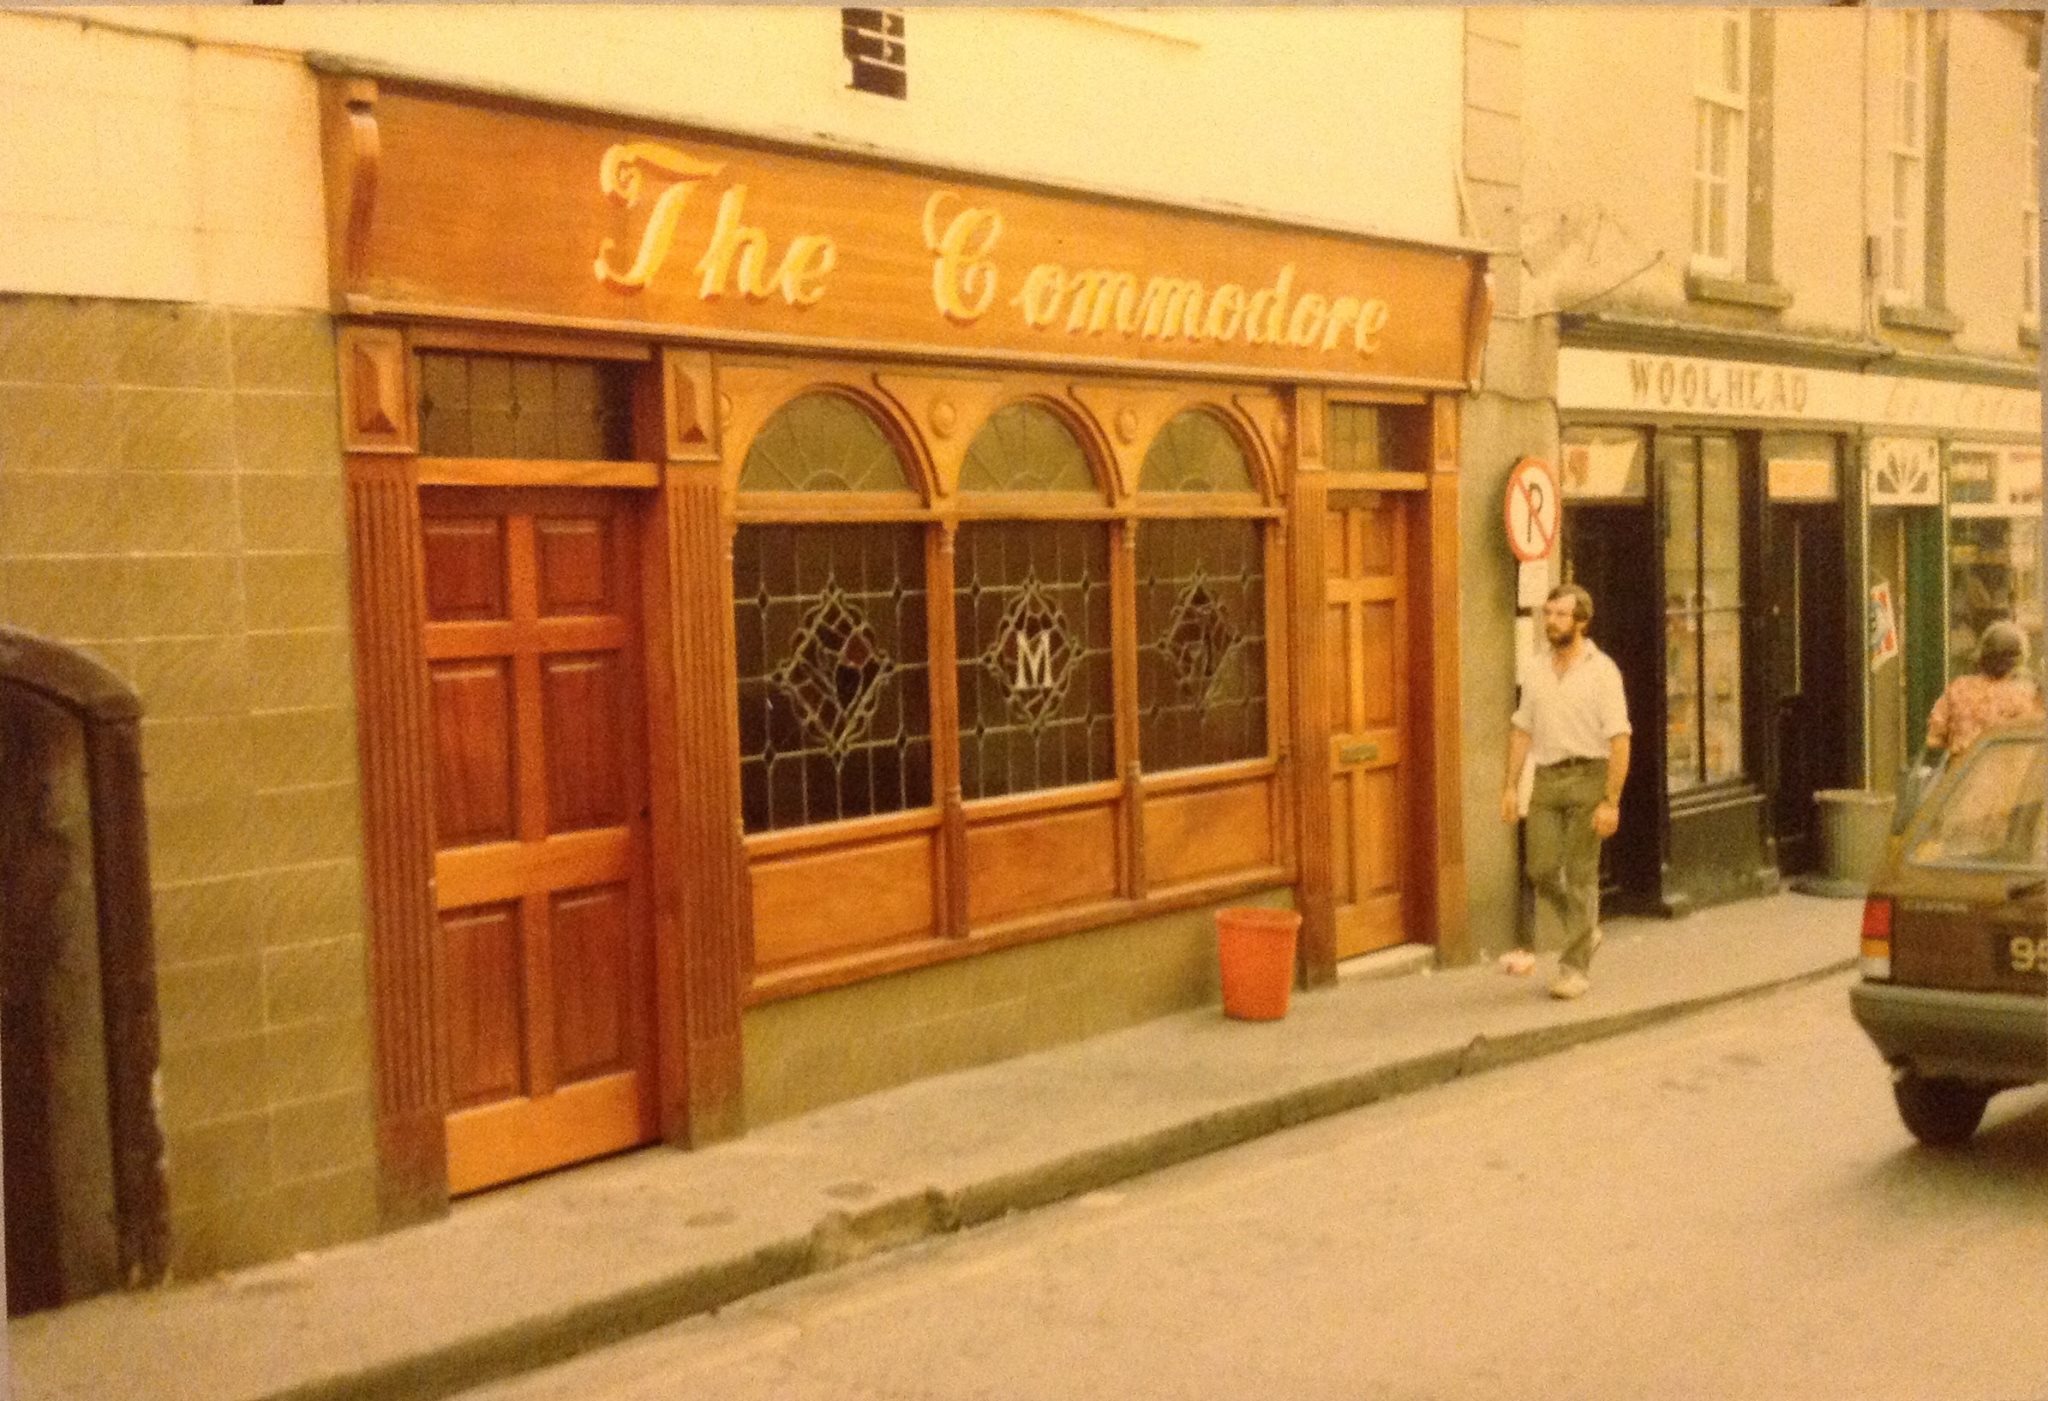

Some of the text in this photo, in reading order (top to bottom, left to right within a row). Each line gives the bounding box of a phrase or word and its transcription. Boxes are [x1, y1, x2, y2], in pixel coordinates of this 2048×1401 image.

[594, 142, 1391, 354] The Commodore
[1629, 357, 1809, 413] WOOLHEAD
